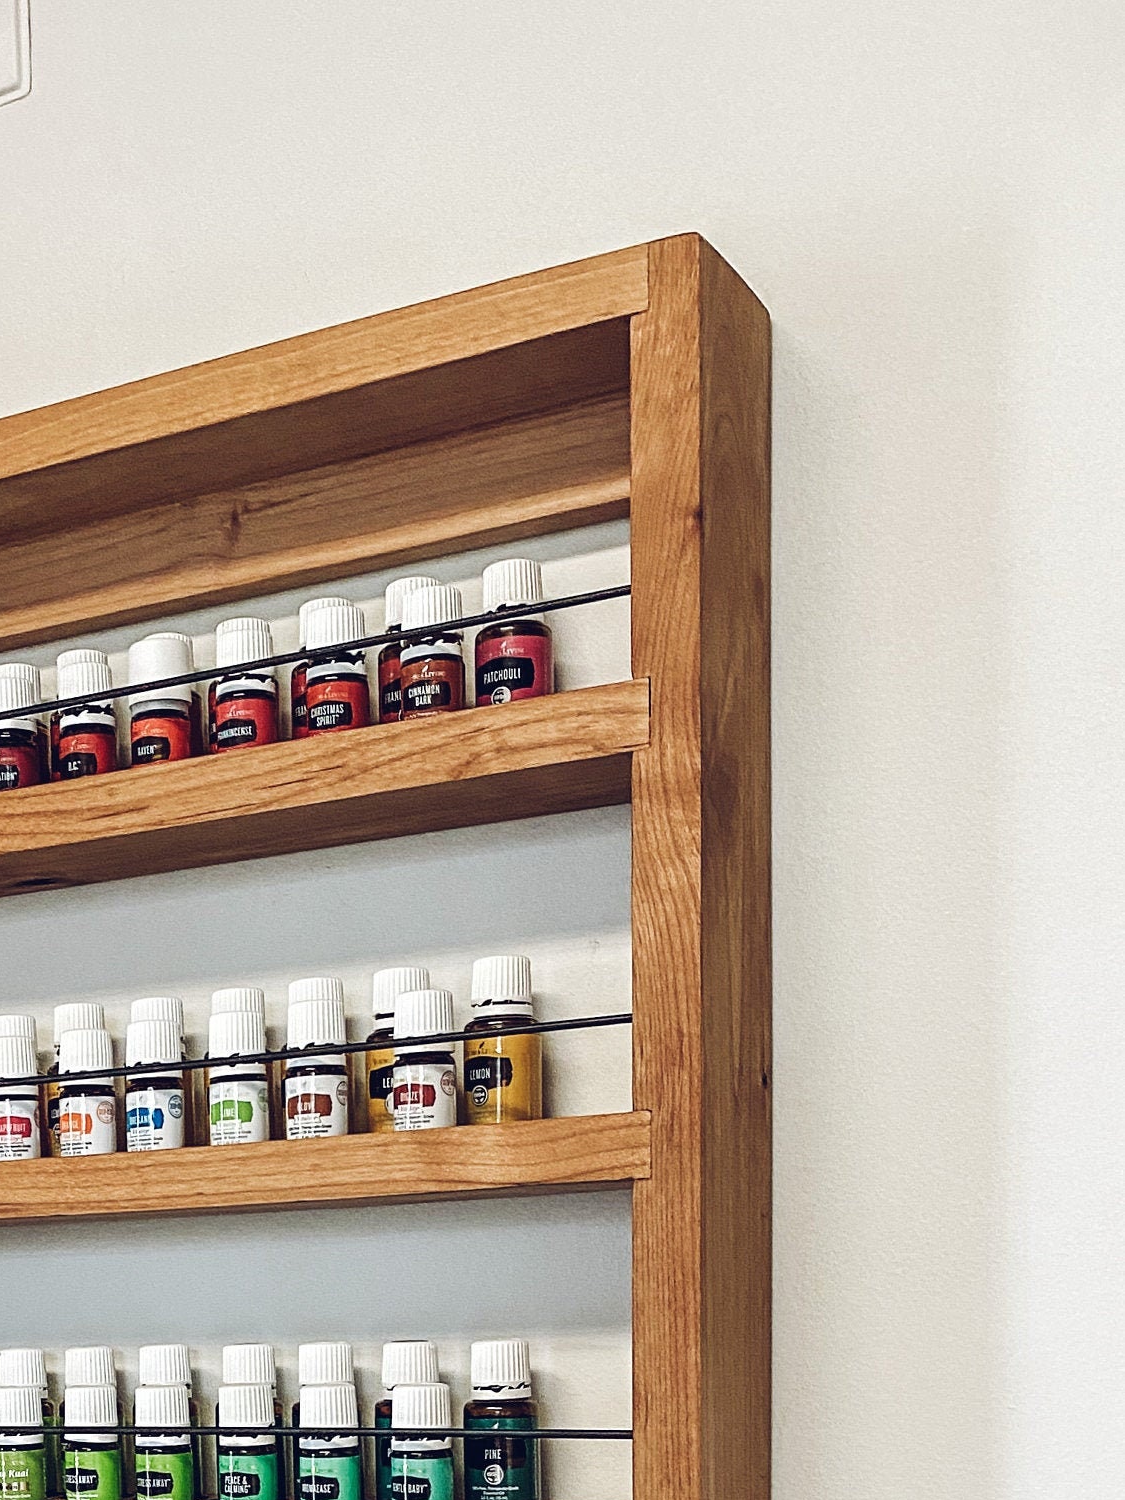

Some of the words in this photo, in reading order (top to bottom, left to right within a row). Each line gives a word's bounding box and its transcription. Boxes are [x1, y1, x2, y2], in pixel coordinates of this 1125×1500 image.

[483, 667, 521, 685] PATCHOULI
[408, 685, 440, 699] CINNAMON
[310, 703, 344, 719] CHRISTMAS
[469, 1067, 491, 1080] LEMON
[484, 1448, 502, 1460] PINE
